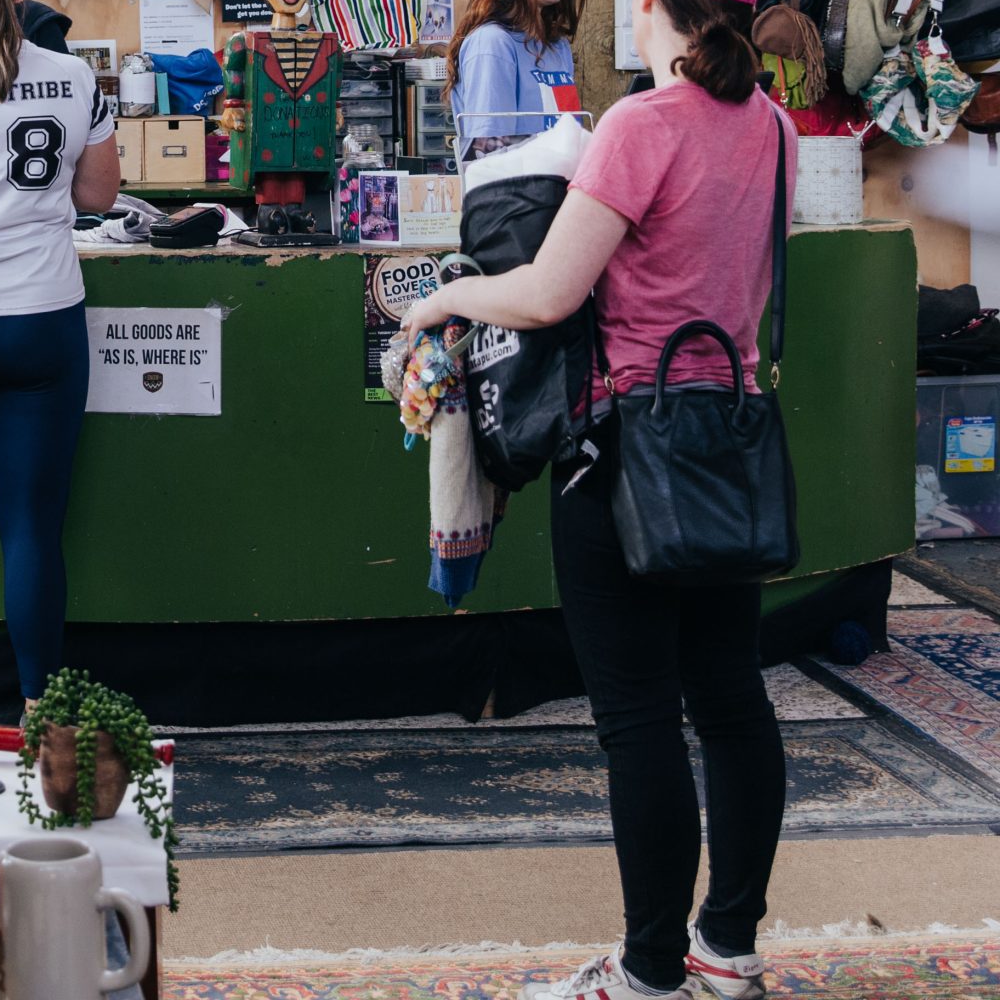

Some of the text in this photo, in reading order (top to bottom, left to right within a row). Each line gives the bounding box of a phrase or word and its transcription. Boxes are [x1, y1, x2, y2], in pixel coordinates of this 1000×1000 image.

[8, 81, 73, 100] TRIBE
[381, 263, 433, 286] FOOD
[106, 323, 200, 340] ALL GOODS ARE
[98, 349, 208, 367] “AS IS, WHERE IS”
